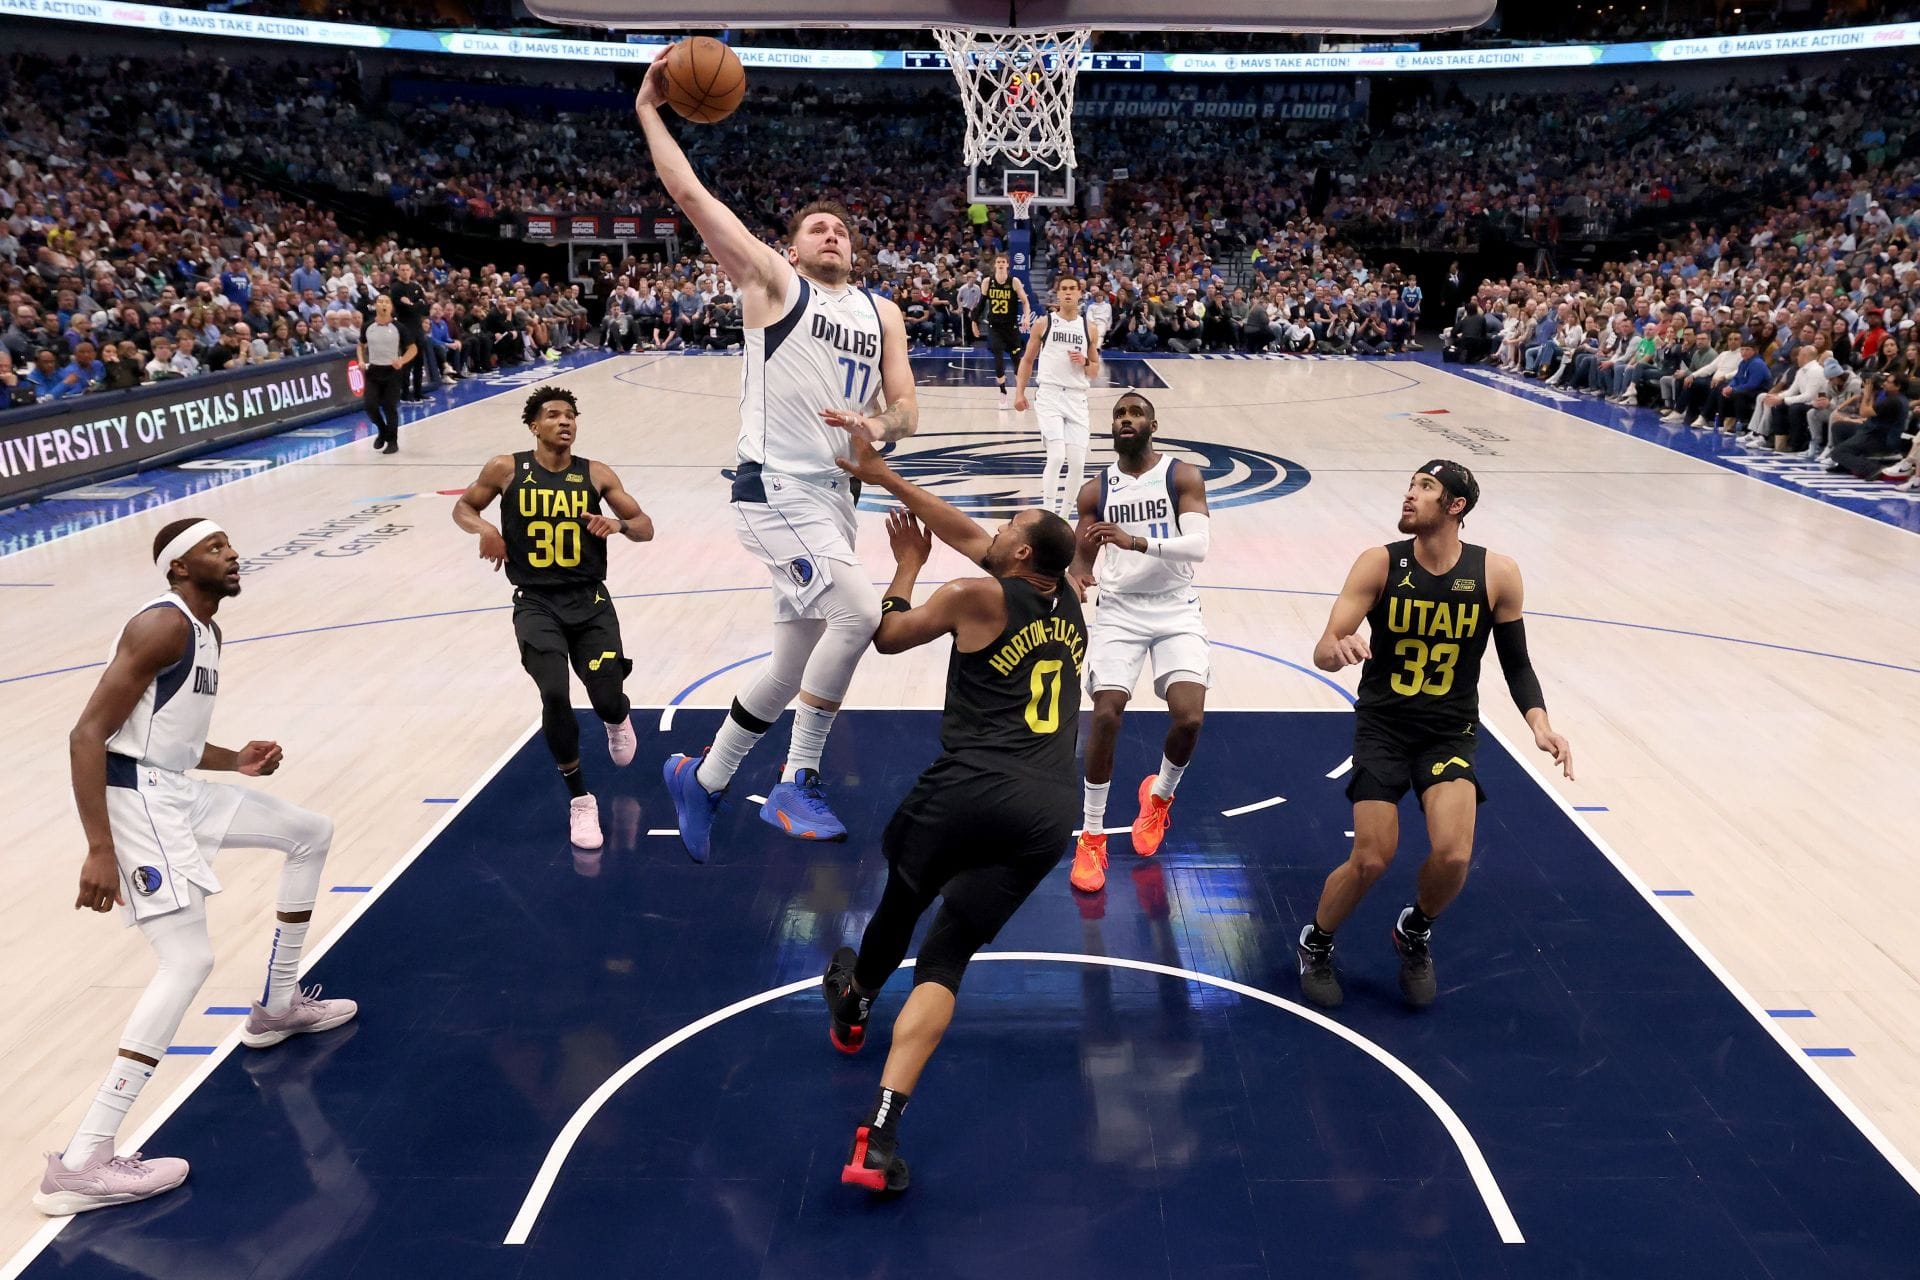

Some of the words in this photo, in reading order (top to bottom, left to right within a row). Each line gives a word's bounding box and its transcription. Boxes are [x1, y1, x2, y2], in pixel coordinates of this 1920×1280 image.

[178, 15, 216, 28] MAVS
[219, 19, 253, 32] TAKE
[257, 23, 310, 36] ACTION!
[525, 43, 559, 54] MAVS
[561, 45, 590, 56] TAKE
[593, 46, 639, 58] ACTION!
[1736, 40, 1772, 51] MAVS
[1775, 36, 1808, 49] TAKE
[1811, 32, 1864, 46] ACTION!
[767, 53, 812, 63] ACTION!
[1240, 59, 1272, 68] MAVS
[1274, 58, 1302, 68] TAKE
[1305, 57, 1350, 67] ACTION!
[1412, 55, 1444, 65] MAVS
[1447, 54, 1474, 64] TAKE
[1478, 52, 1525, 63] ACTION!
[1074, 101, 1108, 116] GET
[1192, 101, 1257, 118] PROUD
[1281, 103, 1337, 119] LOUD!
[989, 289, 1011, 299] UTAH
[991, 300, 1009, 314] 23
[811, 313, 877, 358] DALLAS
[1052, 331, 1083, 345] DALLAS
[837, 356, 871, 403] 77
[135, 408, 167, 444] OF
[169, 392, 240, 435] TEXAS
[243, 385, 265, 419] AT
[265, 372, 332, 412] DALLAS
[519, 488, 588, 518] UTAH
[1108, 498, 1167, 523] DALLAS
[314, 523, 414, 558] Center
[1148, 522, 1169, 539] 11
[527, 520, 581, 568] 30
[1388, 597, 1480, 639] UTAH
[1391, 638, 1460, 696] 33
[193, 665, 219, 696] DALLA
[1025, 660, 1063, 733] 0
